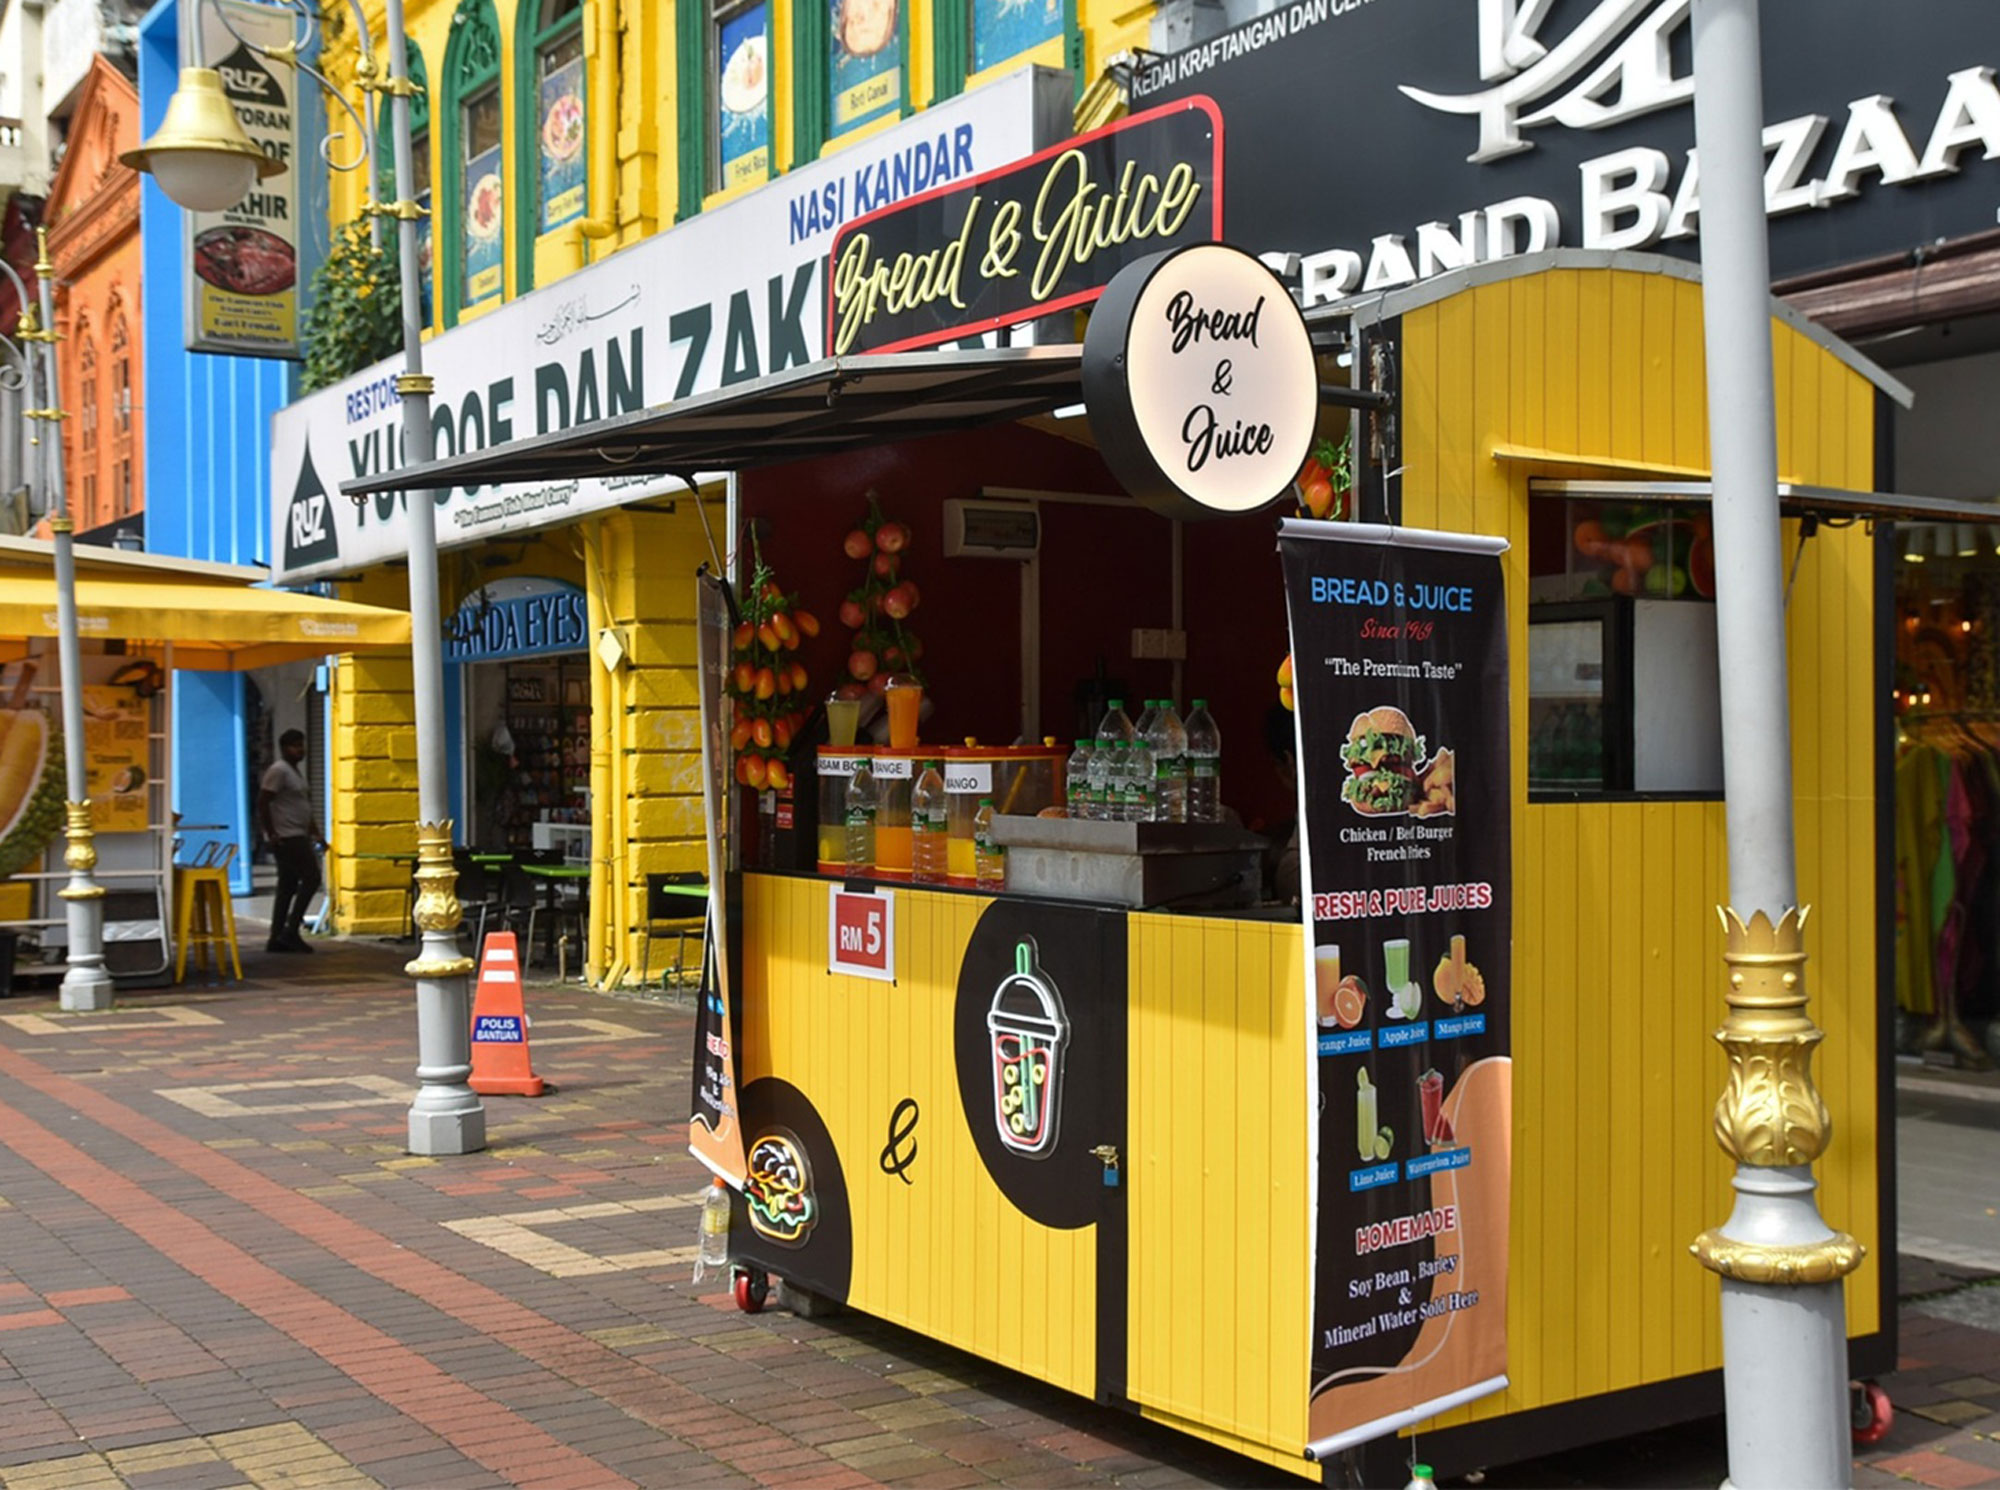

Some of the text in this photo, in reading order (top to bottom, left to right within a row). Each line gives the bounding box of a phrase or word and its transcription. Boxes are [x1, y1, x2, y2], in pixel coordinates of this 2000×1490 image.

[1179, 11, 1286, 80] KRAFTANGAN
[1290, 0, 1328, 34] DAN
[790, 122, 974, 246] NASI KANDAR
[834, 148, 1202, 356] Bread & Juice
[1166, 290, 1265, 354] Bread
[1211, 358, 1233, 396] &
[348, 376, 514, 528] YUOOF
[1182, 404, 1275, 472] Juice
[292, 494, 326, 548] RUZ
[1311, 576, 1473, 612] BREAD & JUICE
[450, 592, 585, 657] PANDA EYES
[1339, 826, 1387, 843] Chicken
[1416, 825, 1454, 841] Burger
[1366, 845, 1406, 862] French
[1368, 889, 1383, 917] &
[1385, 886, 1426, 915] PURE
[1428, 882, 1492, 912] JUICES
[840, 911, 881, 956] RM 5
[476, 1029, 520, 1041] BANTUAN
[481, 1018, 516, 1030] POLIS
[880, 1097, 919, 1185] &
[1356, 1205, 1457, 1256] HOMEMADE
[1349, 1279, 1372, 1298] Soy
[1375, 1268, 1410, 1291] Bean
[1418, 1254, 1459, 1279] Barley
[1398, 1286, 1412, 1306] &
[1324, 1290, 1479, 1349] Mineral Water Sold Here
